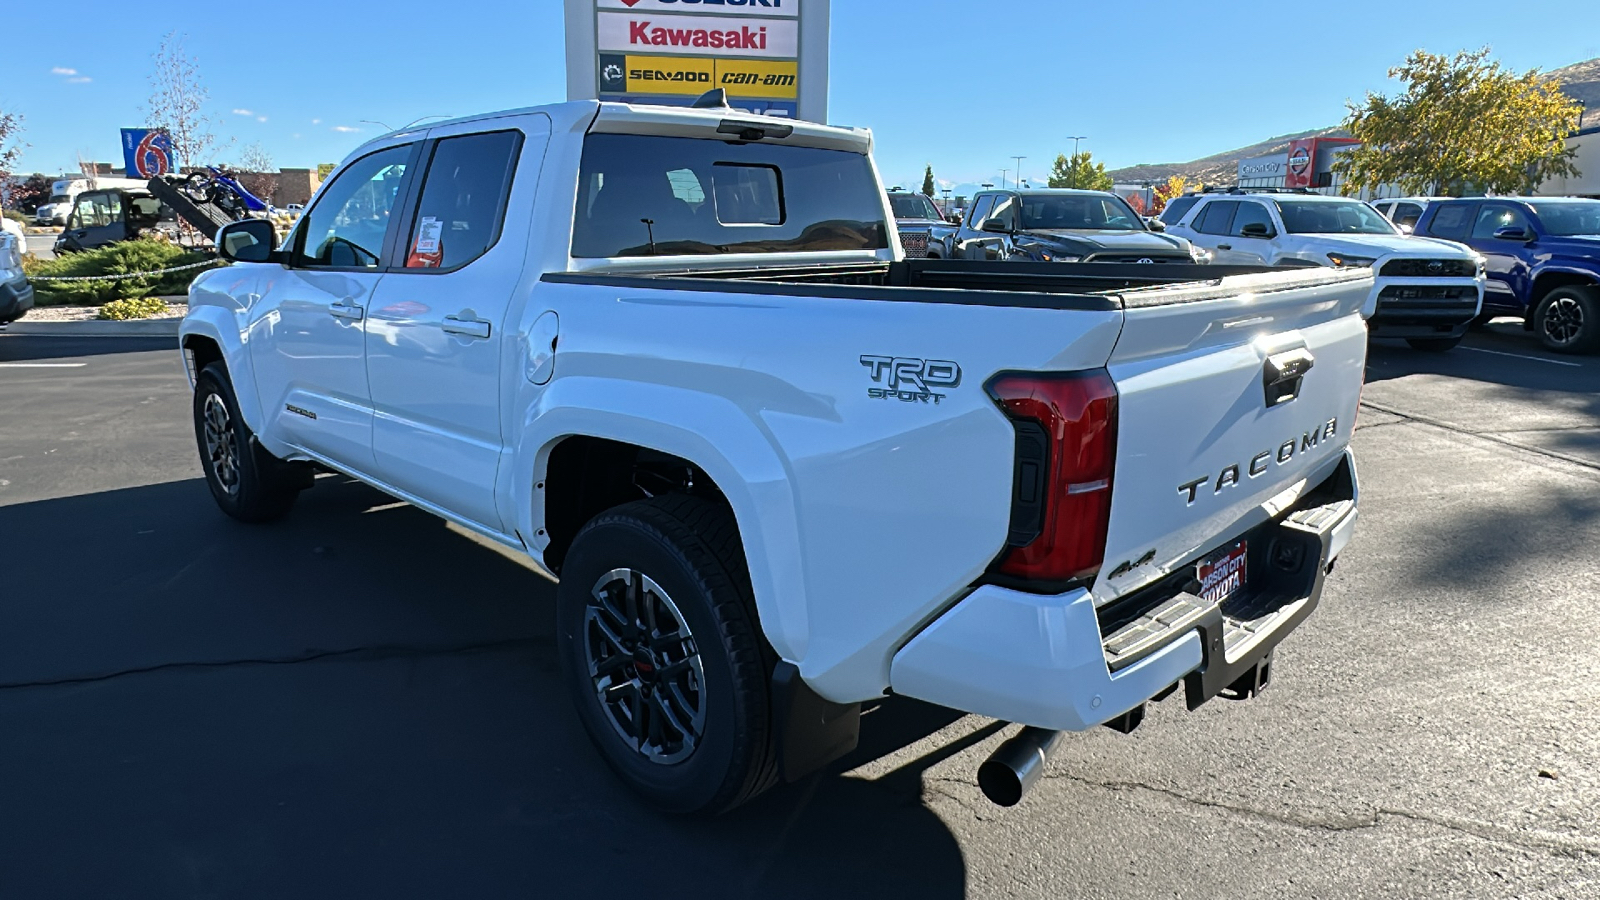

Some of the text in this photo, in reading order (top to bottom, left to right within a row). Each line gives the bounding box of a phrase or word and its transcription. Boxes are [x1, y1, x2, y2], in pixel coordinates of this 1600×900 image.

[629, 21, 767, 49] Kawasaki
[721, 72, 796, 86] can-am
[1241, 161, 1280, 175] Carson City
[860, 355, 962, 390] TRD
[867, 387, 947, 406] SPORT
[1176, 416, 1337, 506] TACOMA
[1229, 551, 1246, 572] CITY
